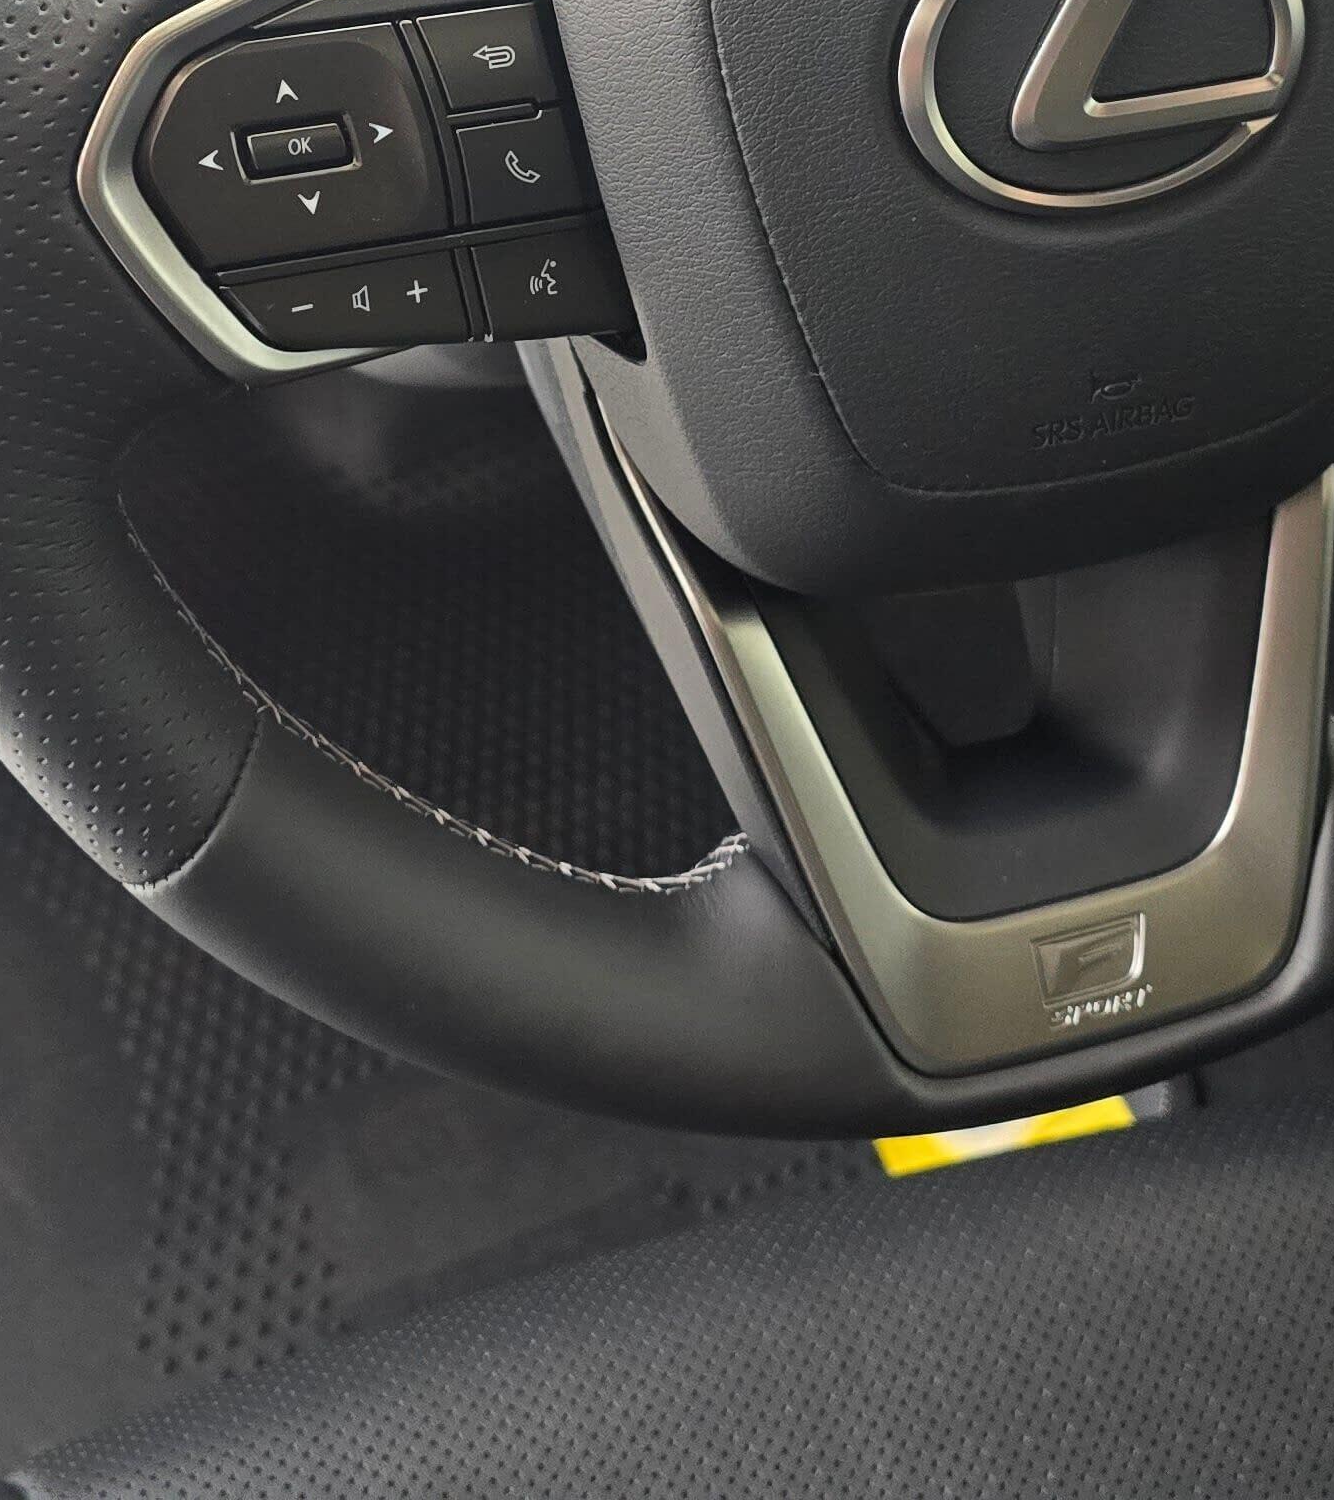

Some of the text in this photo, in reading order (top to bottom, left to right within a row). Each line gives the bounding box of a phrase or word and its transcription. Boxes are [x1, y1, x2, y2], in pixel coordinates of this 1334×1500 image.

[287, 136, 313, 156] OK
[1030, 396, 1196, 450] SRS AIRBAG
